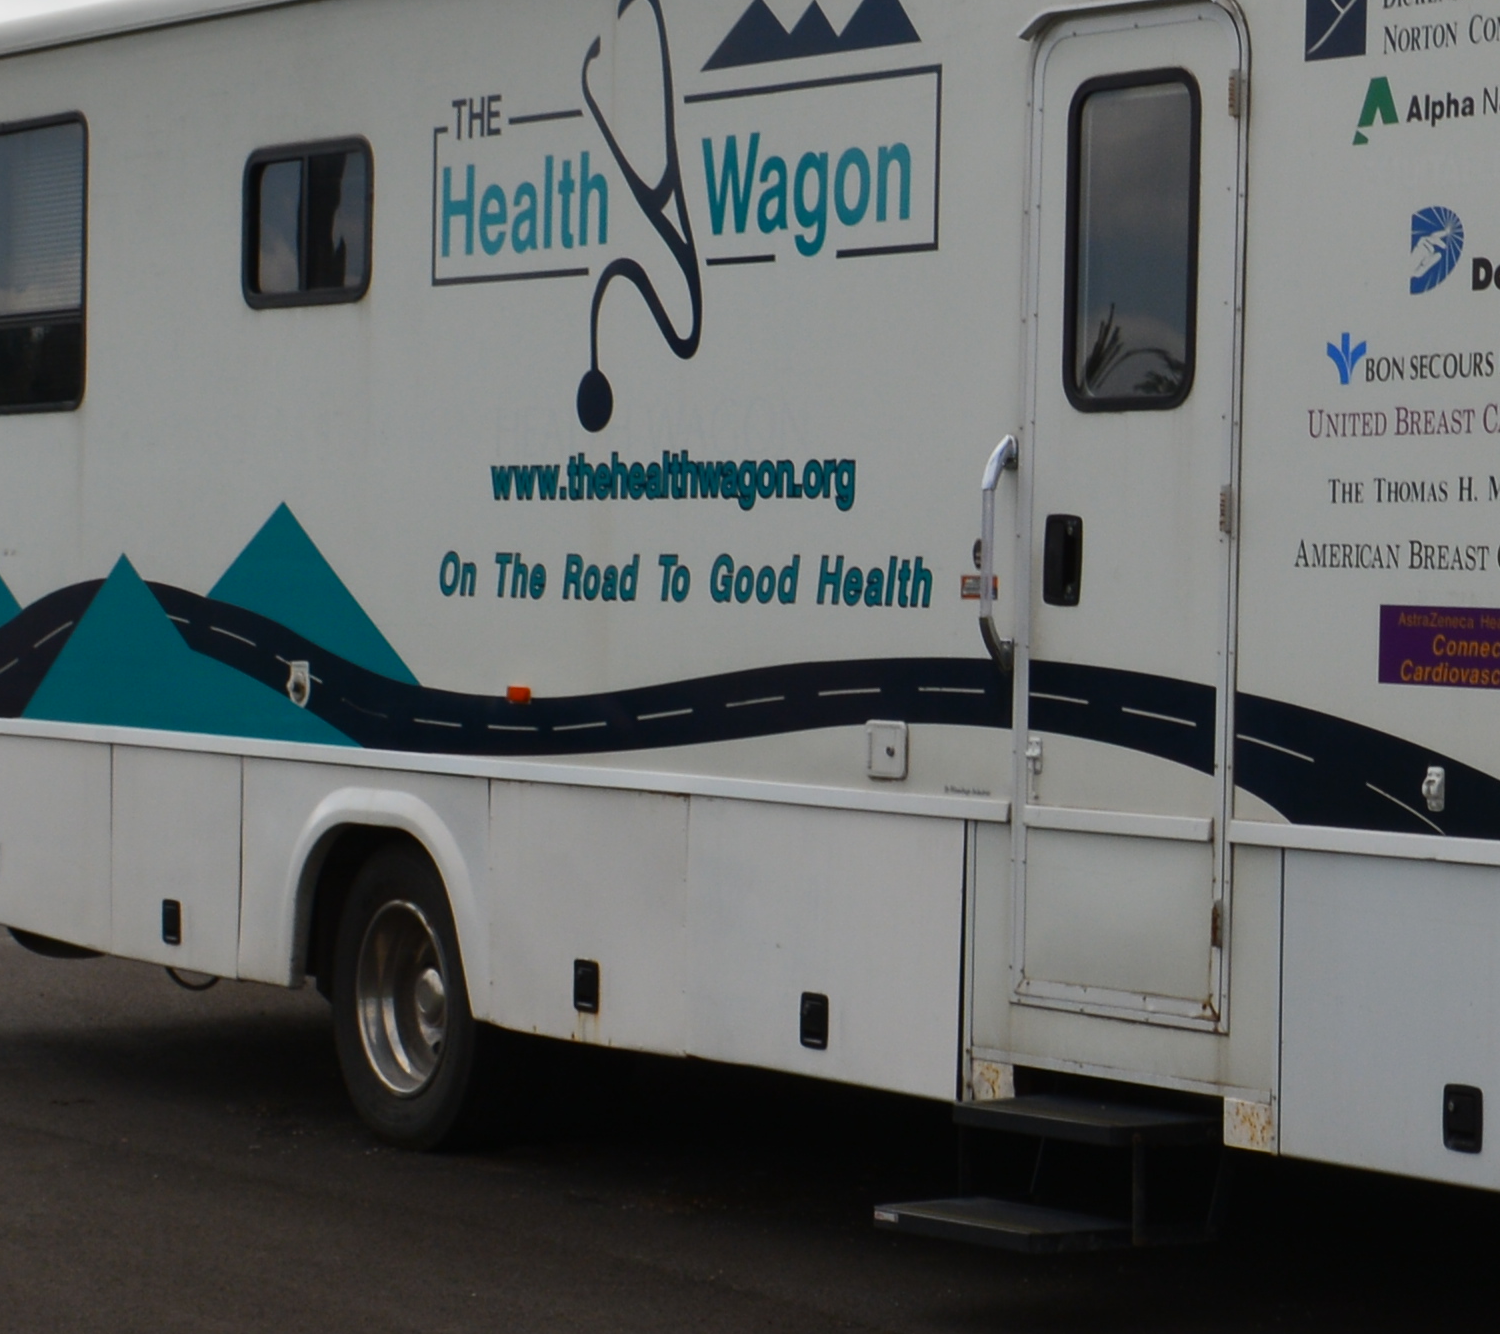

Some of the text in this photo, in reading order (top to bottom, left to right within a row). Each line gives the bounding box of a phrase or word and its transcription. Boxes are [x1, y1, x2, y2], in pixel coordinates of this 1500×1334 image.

[1383, 21, 1458, 55] NORTON
[452, 95, 501, 139] THE
[1406, 91, 1475, 128] Alpha
[441, 131, 911, 258] Health Wagon
[1365, 356, 1405, 383] BON
[1409, 352, 1495, 381] SECOURS
[1307, 408, 1387, 439] UNITED
[1393, 405, 1476, 437] BREAST
[490, 450, 856, 511] www.thehealthwagon.org
[1328, 478, 1364, 504] THE
[1373, 477, 1449, 503] THOMAS
[1458, 476, 1479, 502] H.
[1294, 539, 1401, 569] AMERICAN
[1408, 540, 1490, 571] BREAST
[438, 550, 476, 597] On
[495, 551, 547, 600] The
[561, 552, 640, 602] Road
[658, 553, 691, 602] To
[709, 553, 801, 604] Good
[816, 554, 933, 609] Health
[1398, 612, 1475, 630] AstraZeneca
